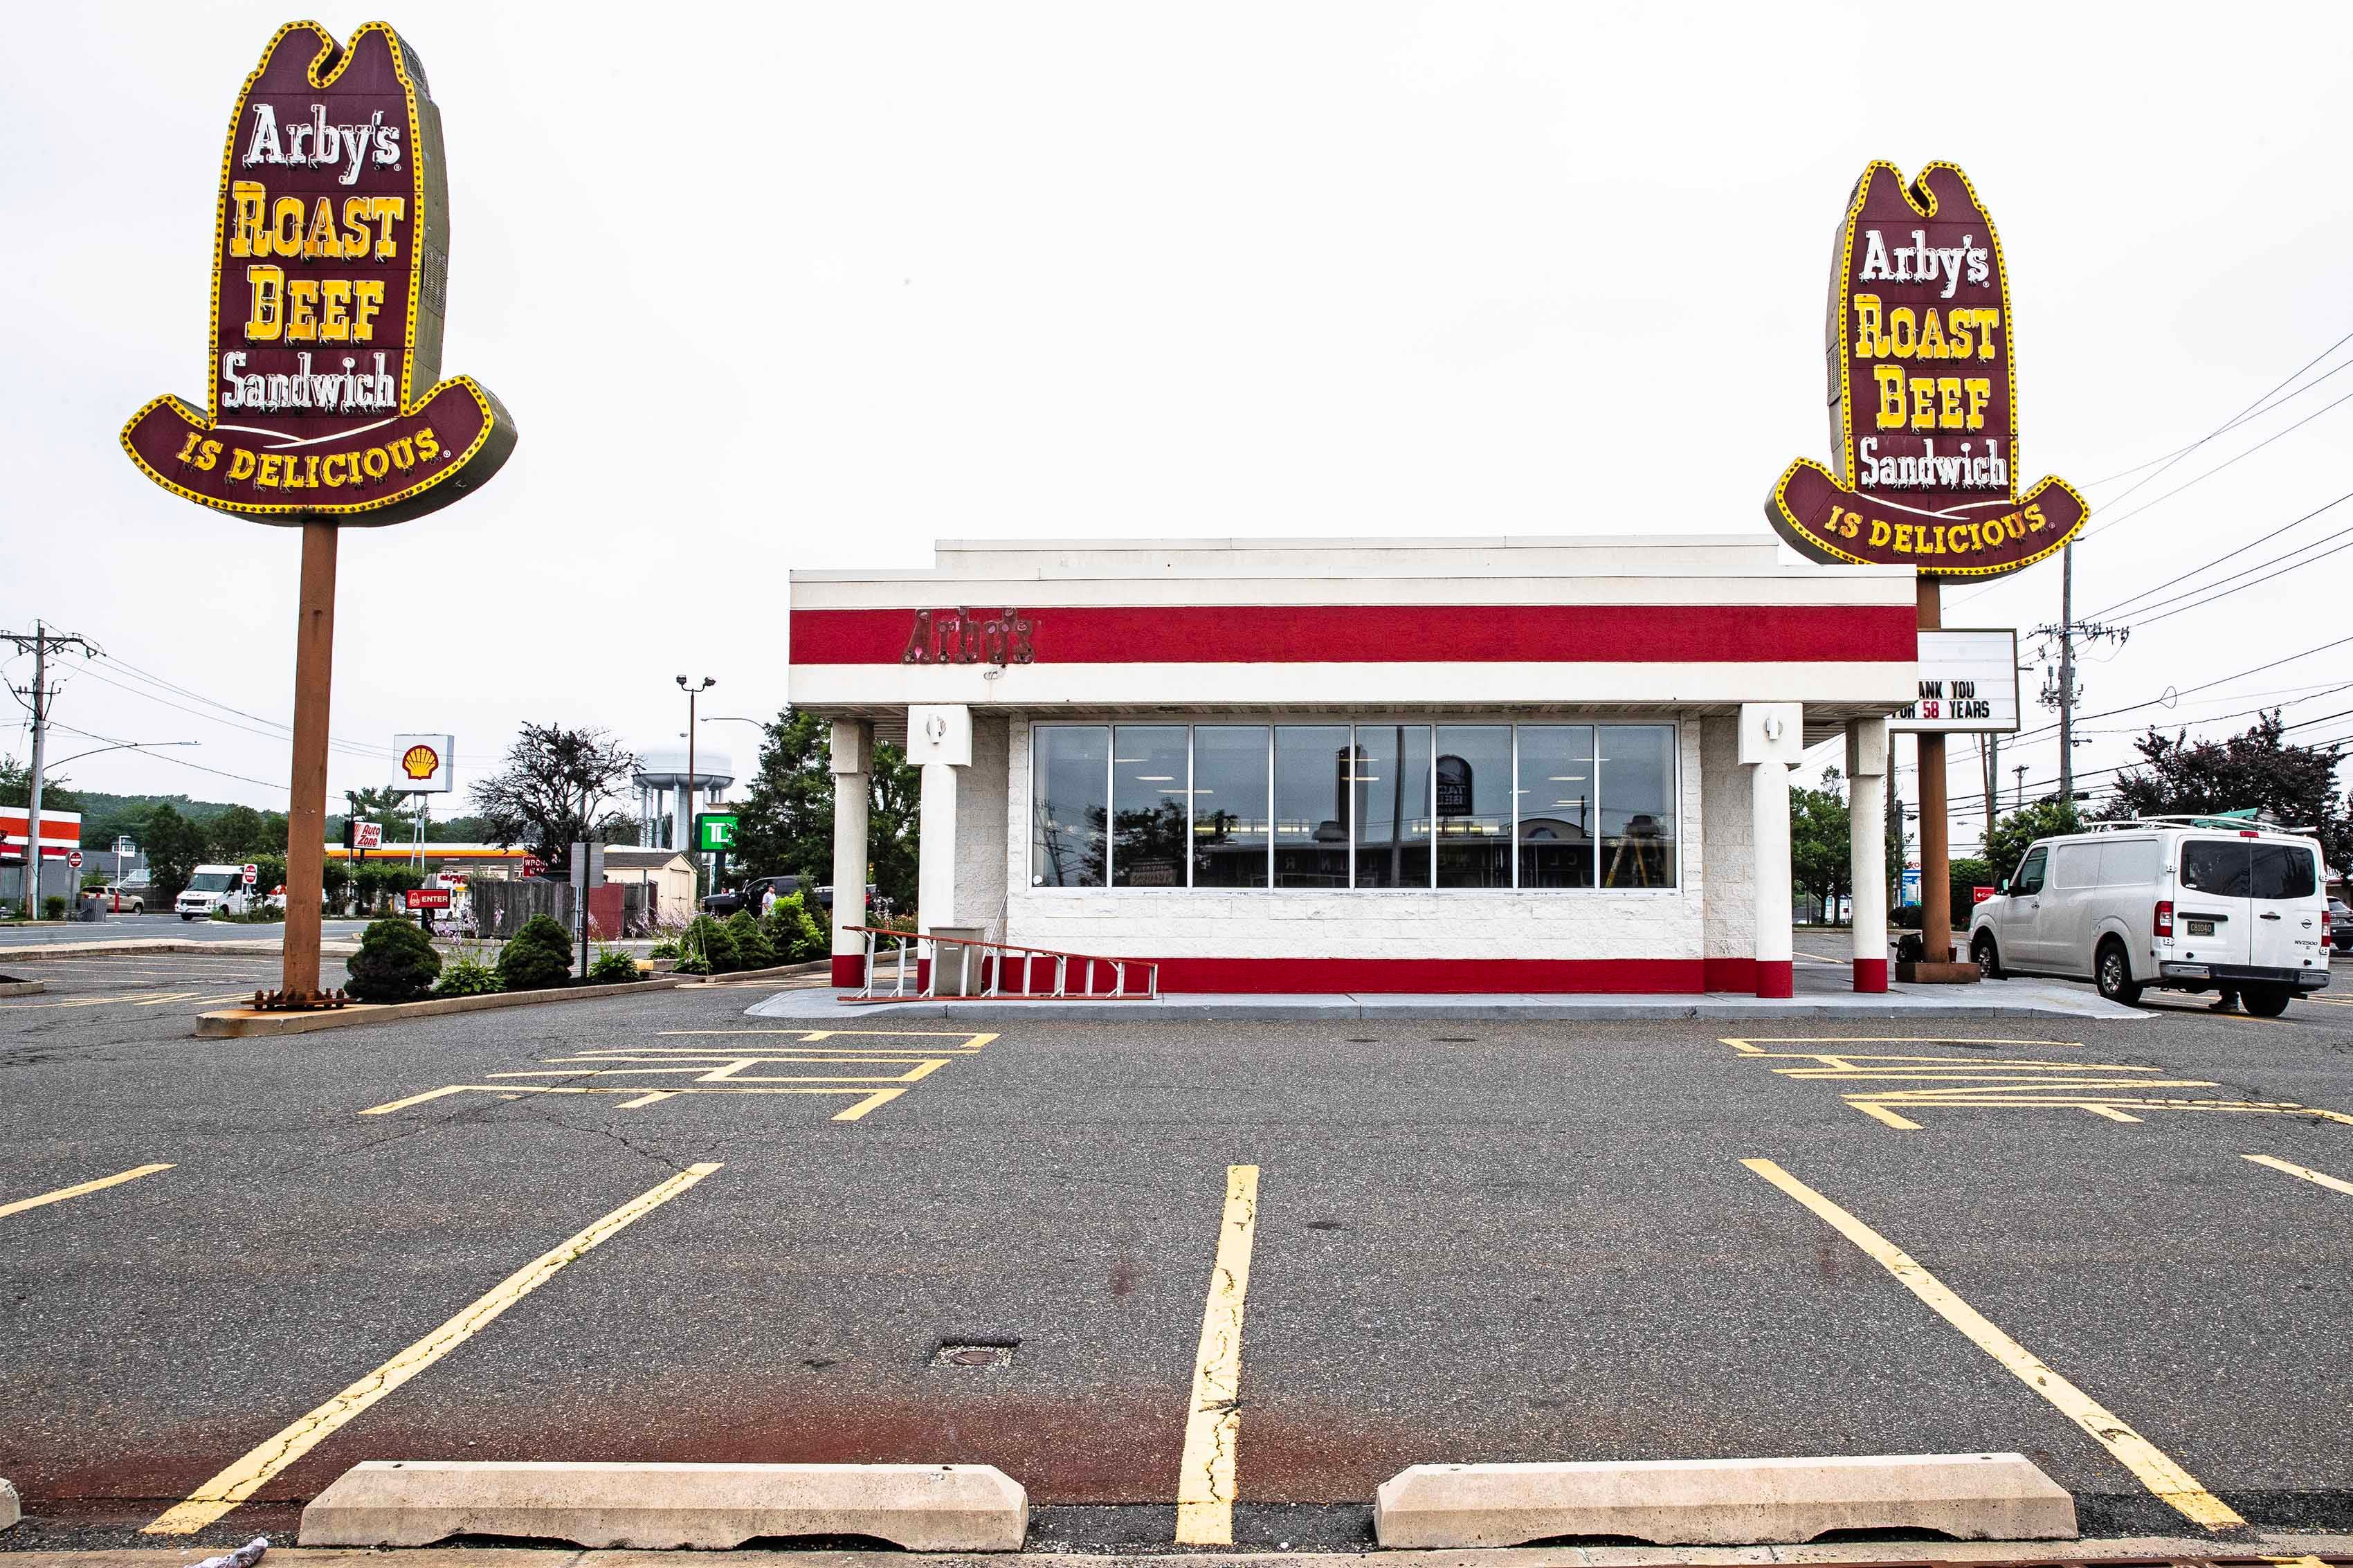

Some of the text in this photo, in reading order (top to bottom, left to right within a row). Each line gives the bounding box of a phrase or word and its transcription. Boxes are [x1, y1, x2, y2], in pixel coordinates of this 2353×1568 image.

[242, 104, 401, 185] Arby's
[229, 181, 406, 258] ROAST
[1859, 230, 1990, 298] Arby's
[244, 265, 385, 341] BEEF
[1853, 294, 1999, 360] ROAST
[223, 352, 397, 409] Sandwich
[1873, 365, 1991, 429] BEEF
[177, 427, 441, 489] IS DELICIOUS
[1860, 437, 2008, 486] Sandwich
[1824, 503, 2047, 554] IS DELICIOUS
[1918, 681, 1975, 699] ANK YOU
[1923, 701, 1939, 718] 58
[1949, 701, 1990, 718] YEARS
[357, 835, 378, 846] Zone
[362, 824, 381, 836] Auto
